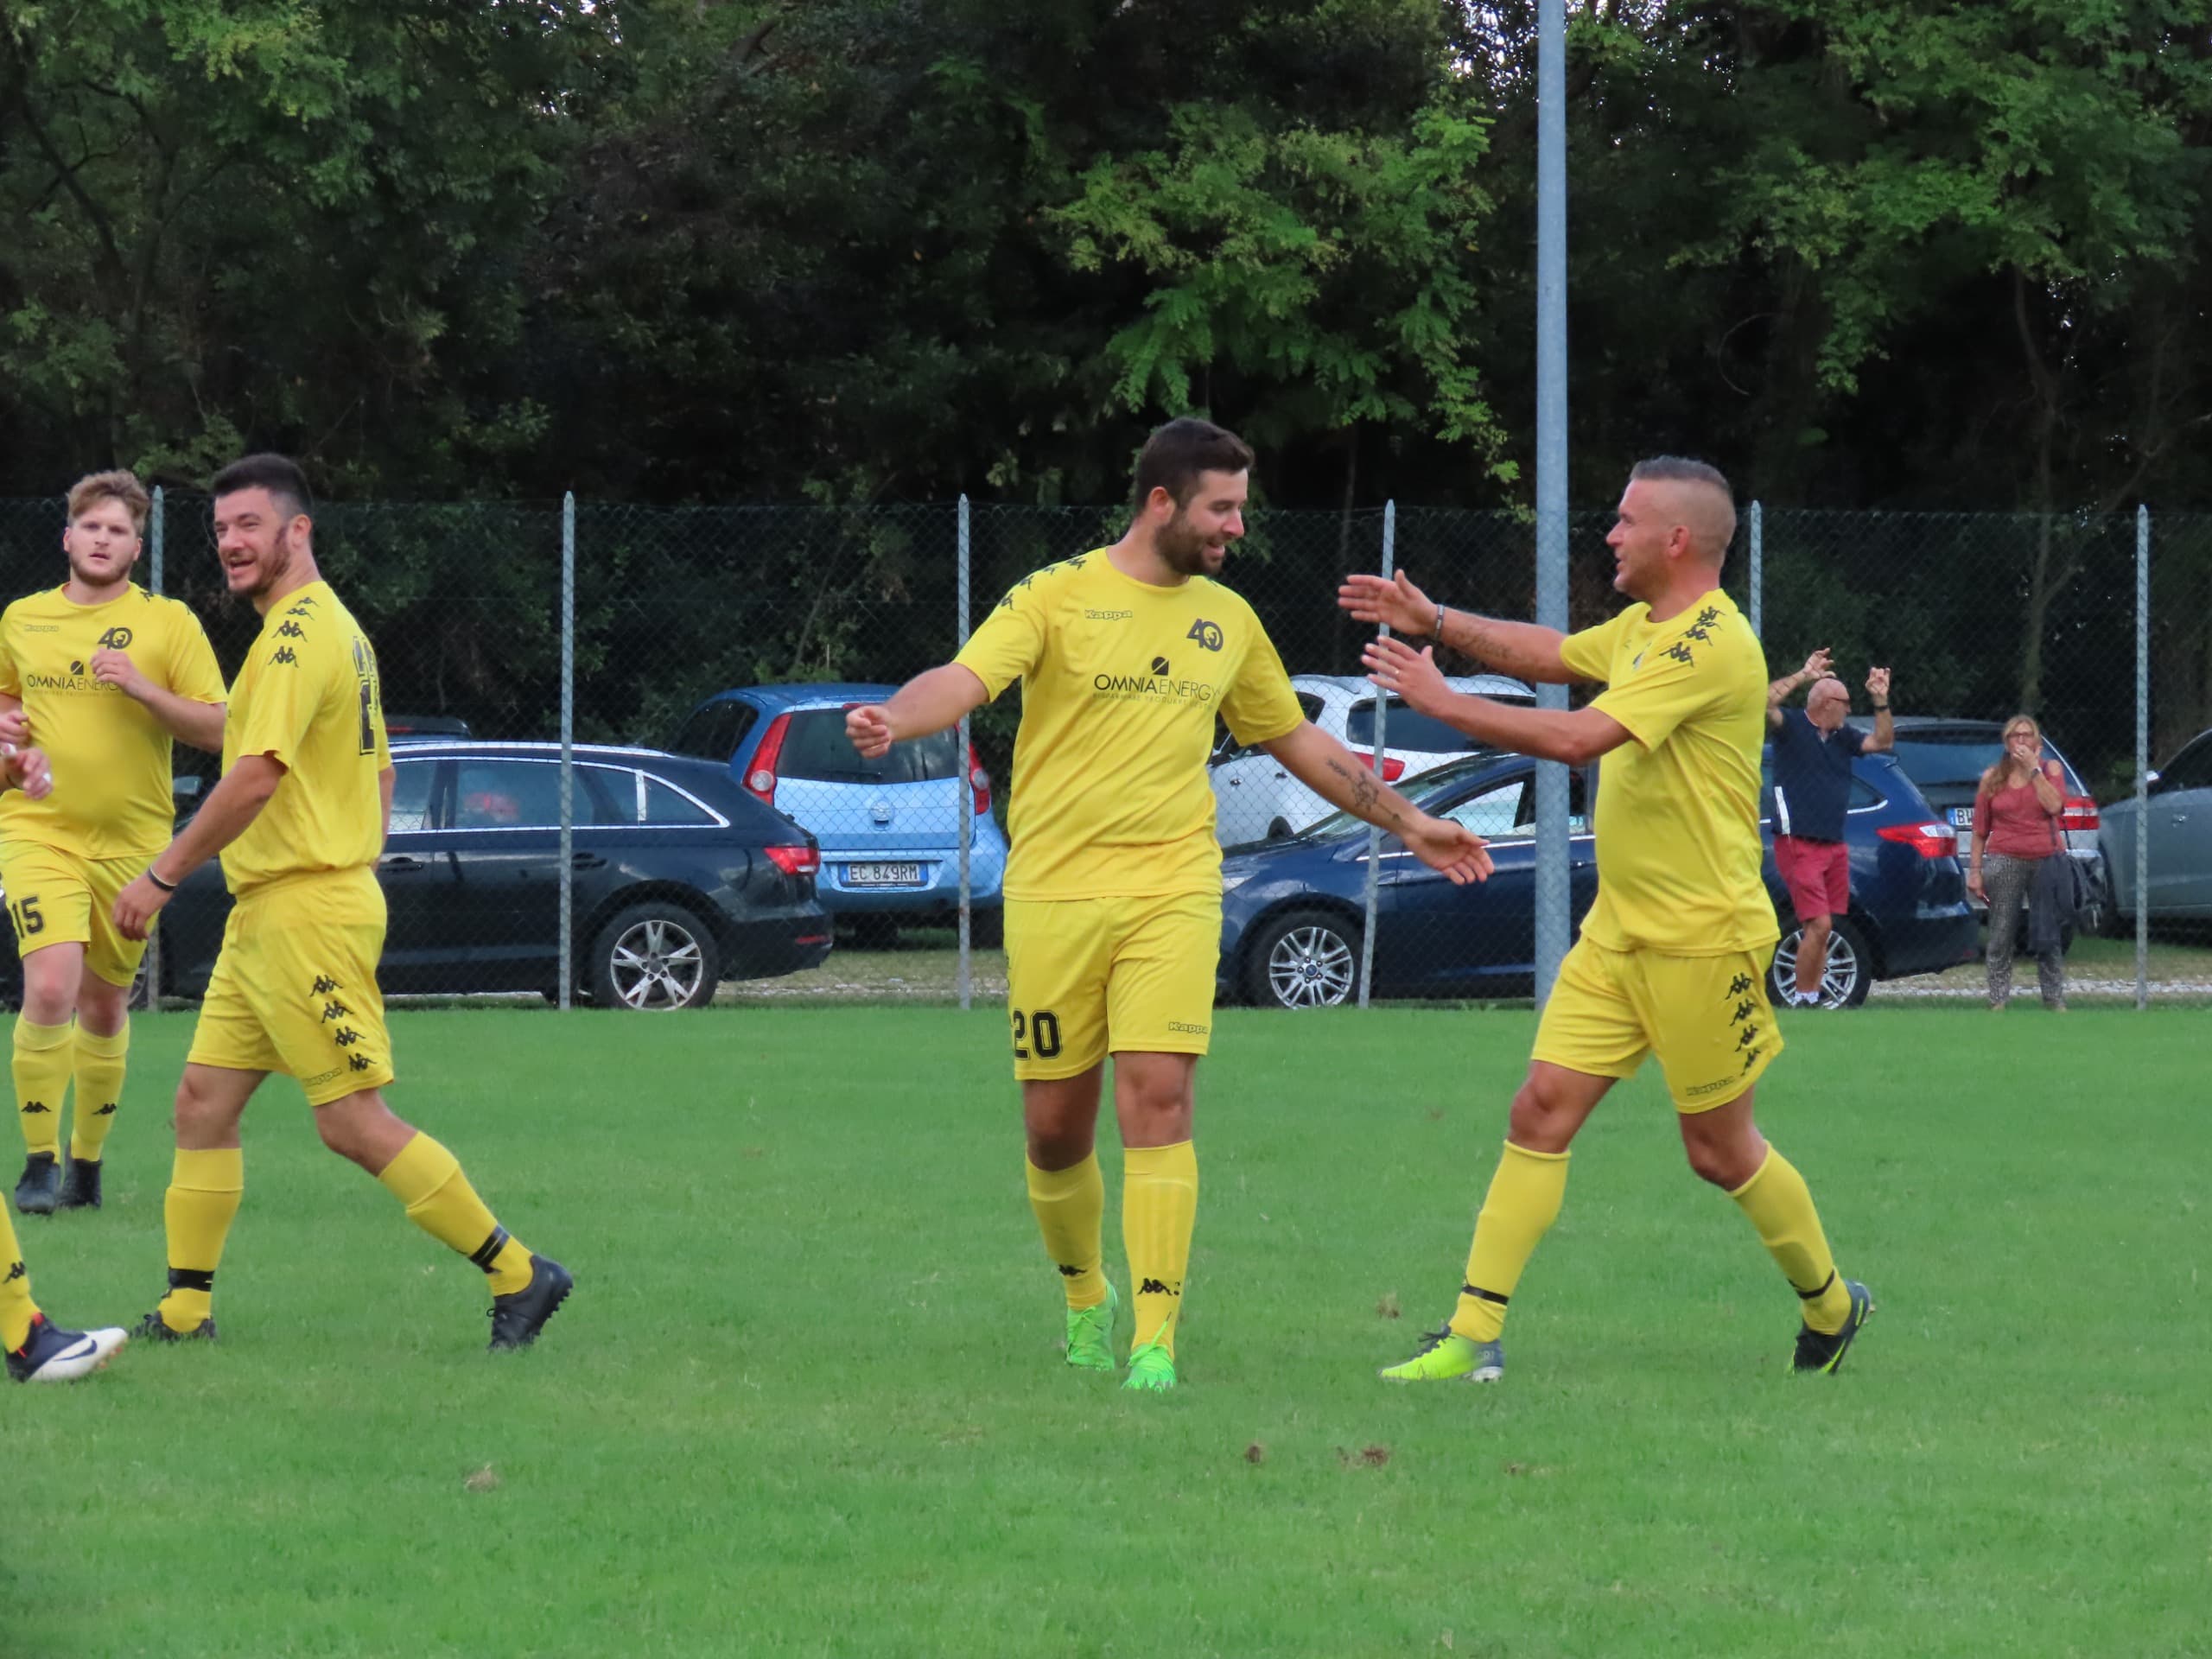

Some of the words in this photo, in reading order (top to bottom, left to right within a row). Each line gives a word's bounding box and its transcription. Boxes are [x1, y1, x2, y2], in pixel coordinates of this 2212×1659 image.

[1084, 609, 1133, 620] Kappa
[850, 866, 868, 880] EC
[874, 866, 918, 880] 849RM
[12, 895, 45, 939] 15
[1013, 1008, 1063, 1059] 20
